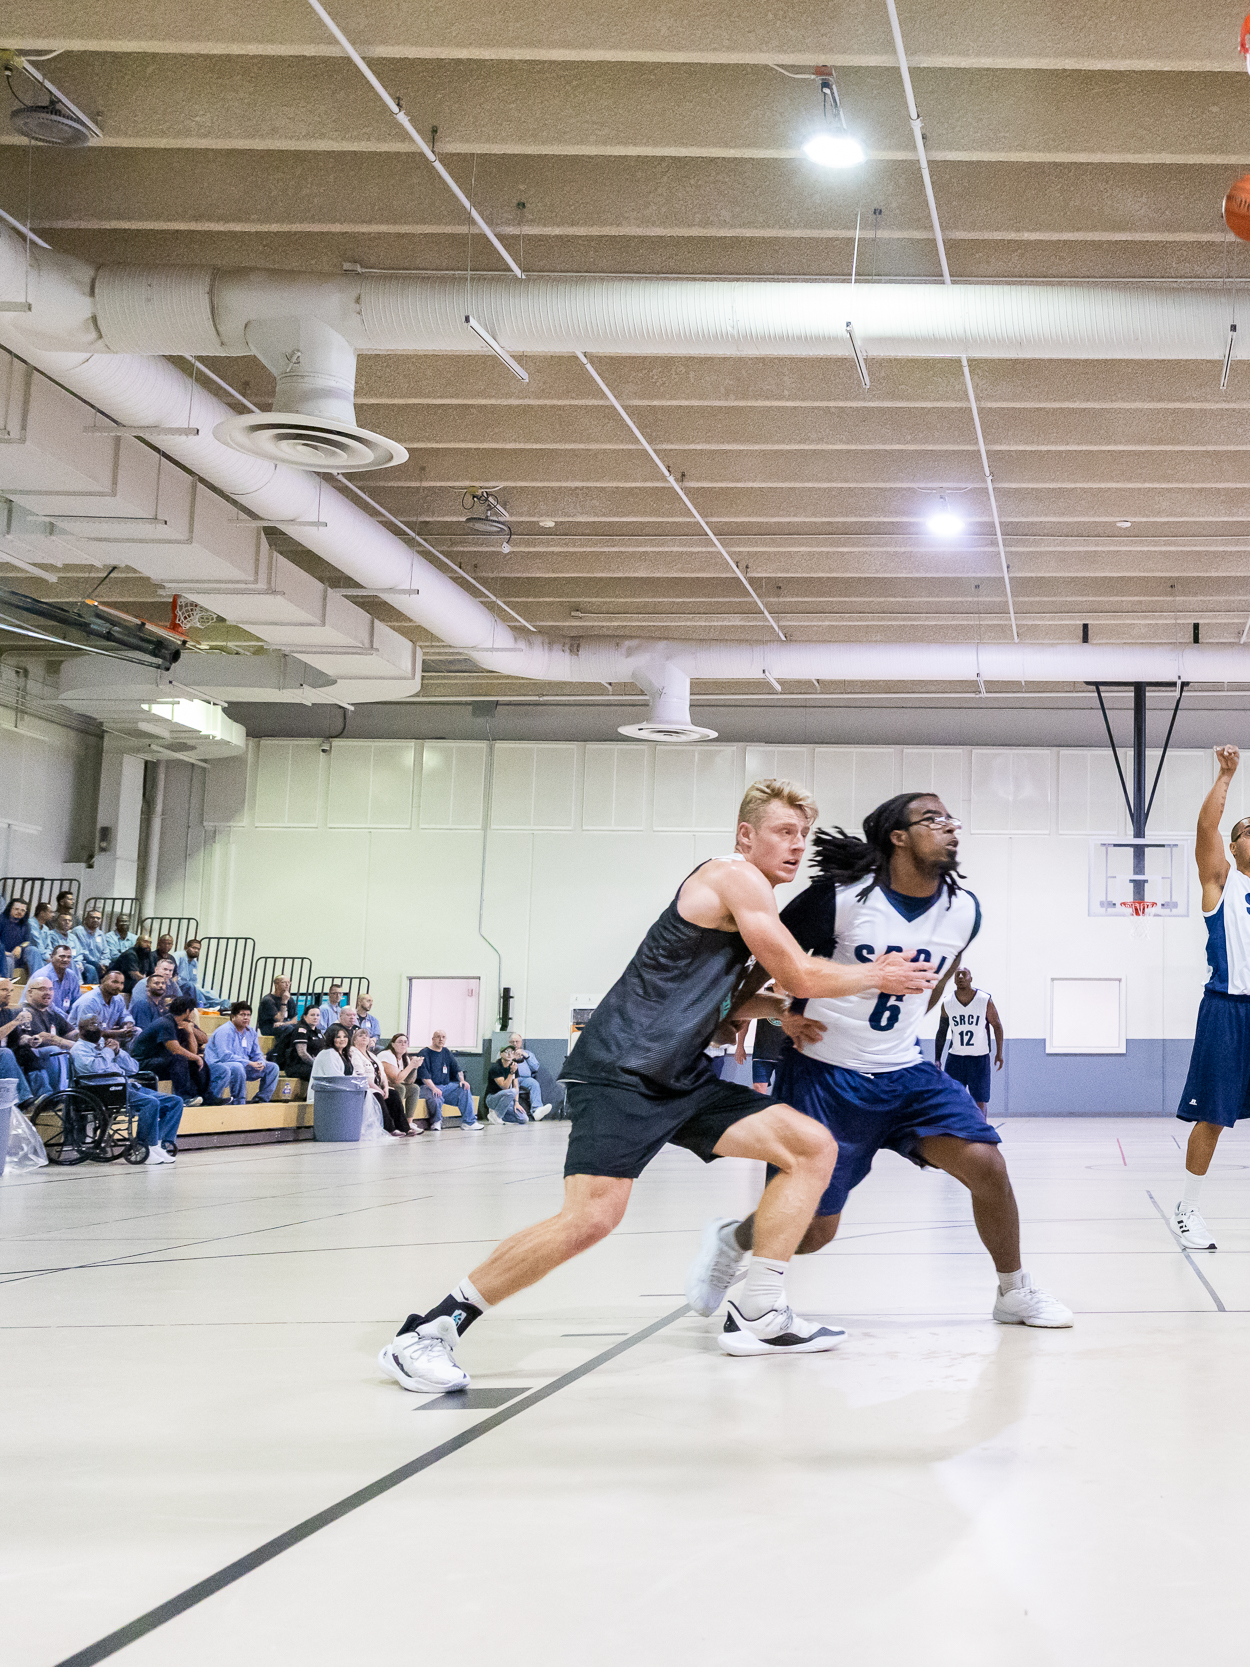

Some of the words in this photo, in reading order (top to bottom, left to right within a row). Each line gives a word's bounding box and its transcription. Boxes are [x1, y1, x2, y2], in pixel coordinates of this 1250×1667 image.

[867, 991, 906, 1032] 6
[951, 1013, 980, 1027] SRCI
[958, 1029, 975, 1047] 12
